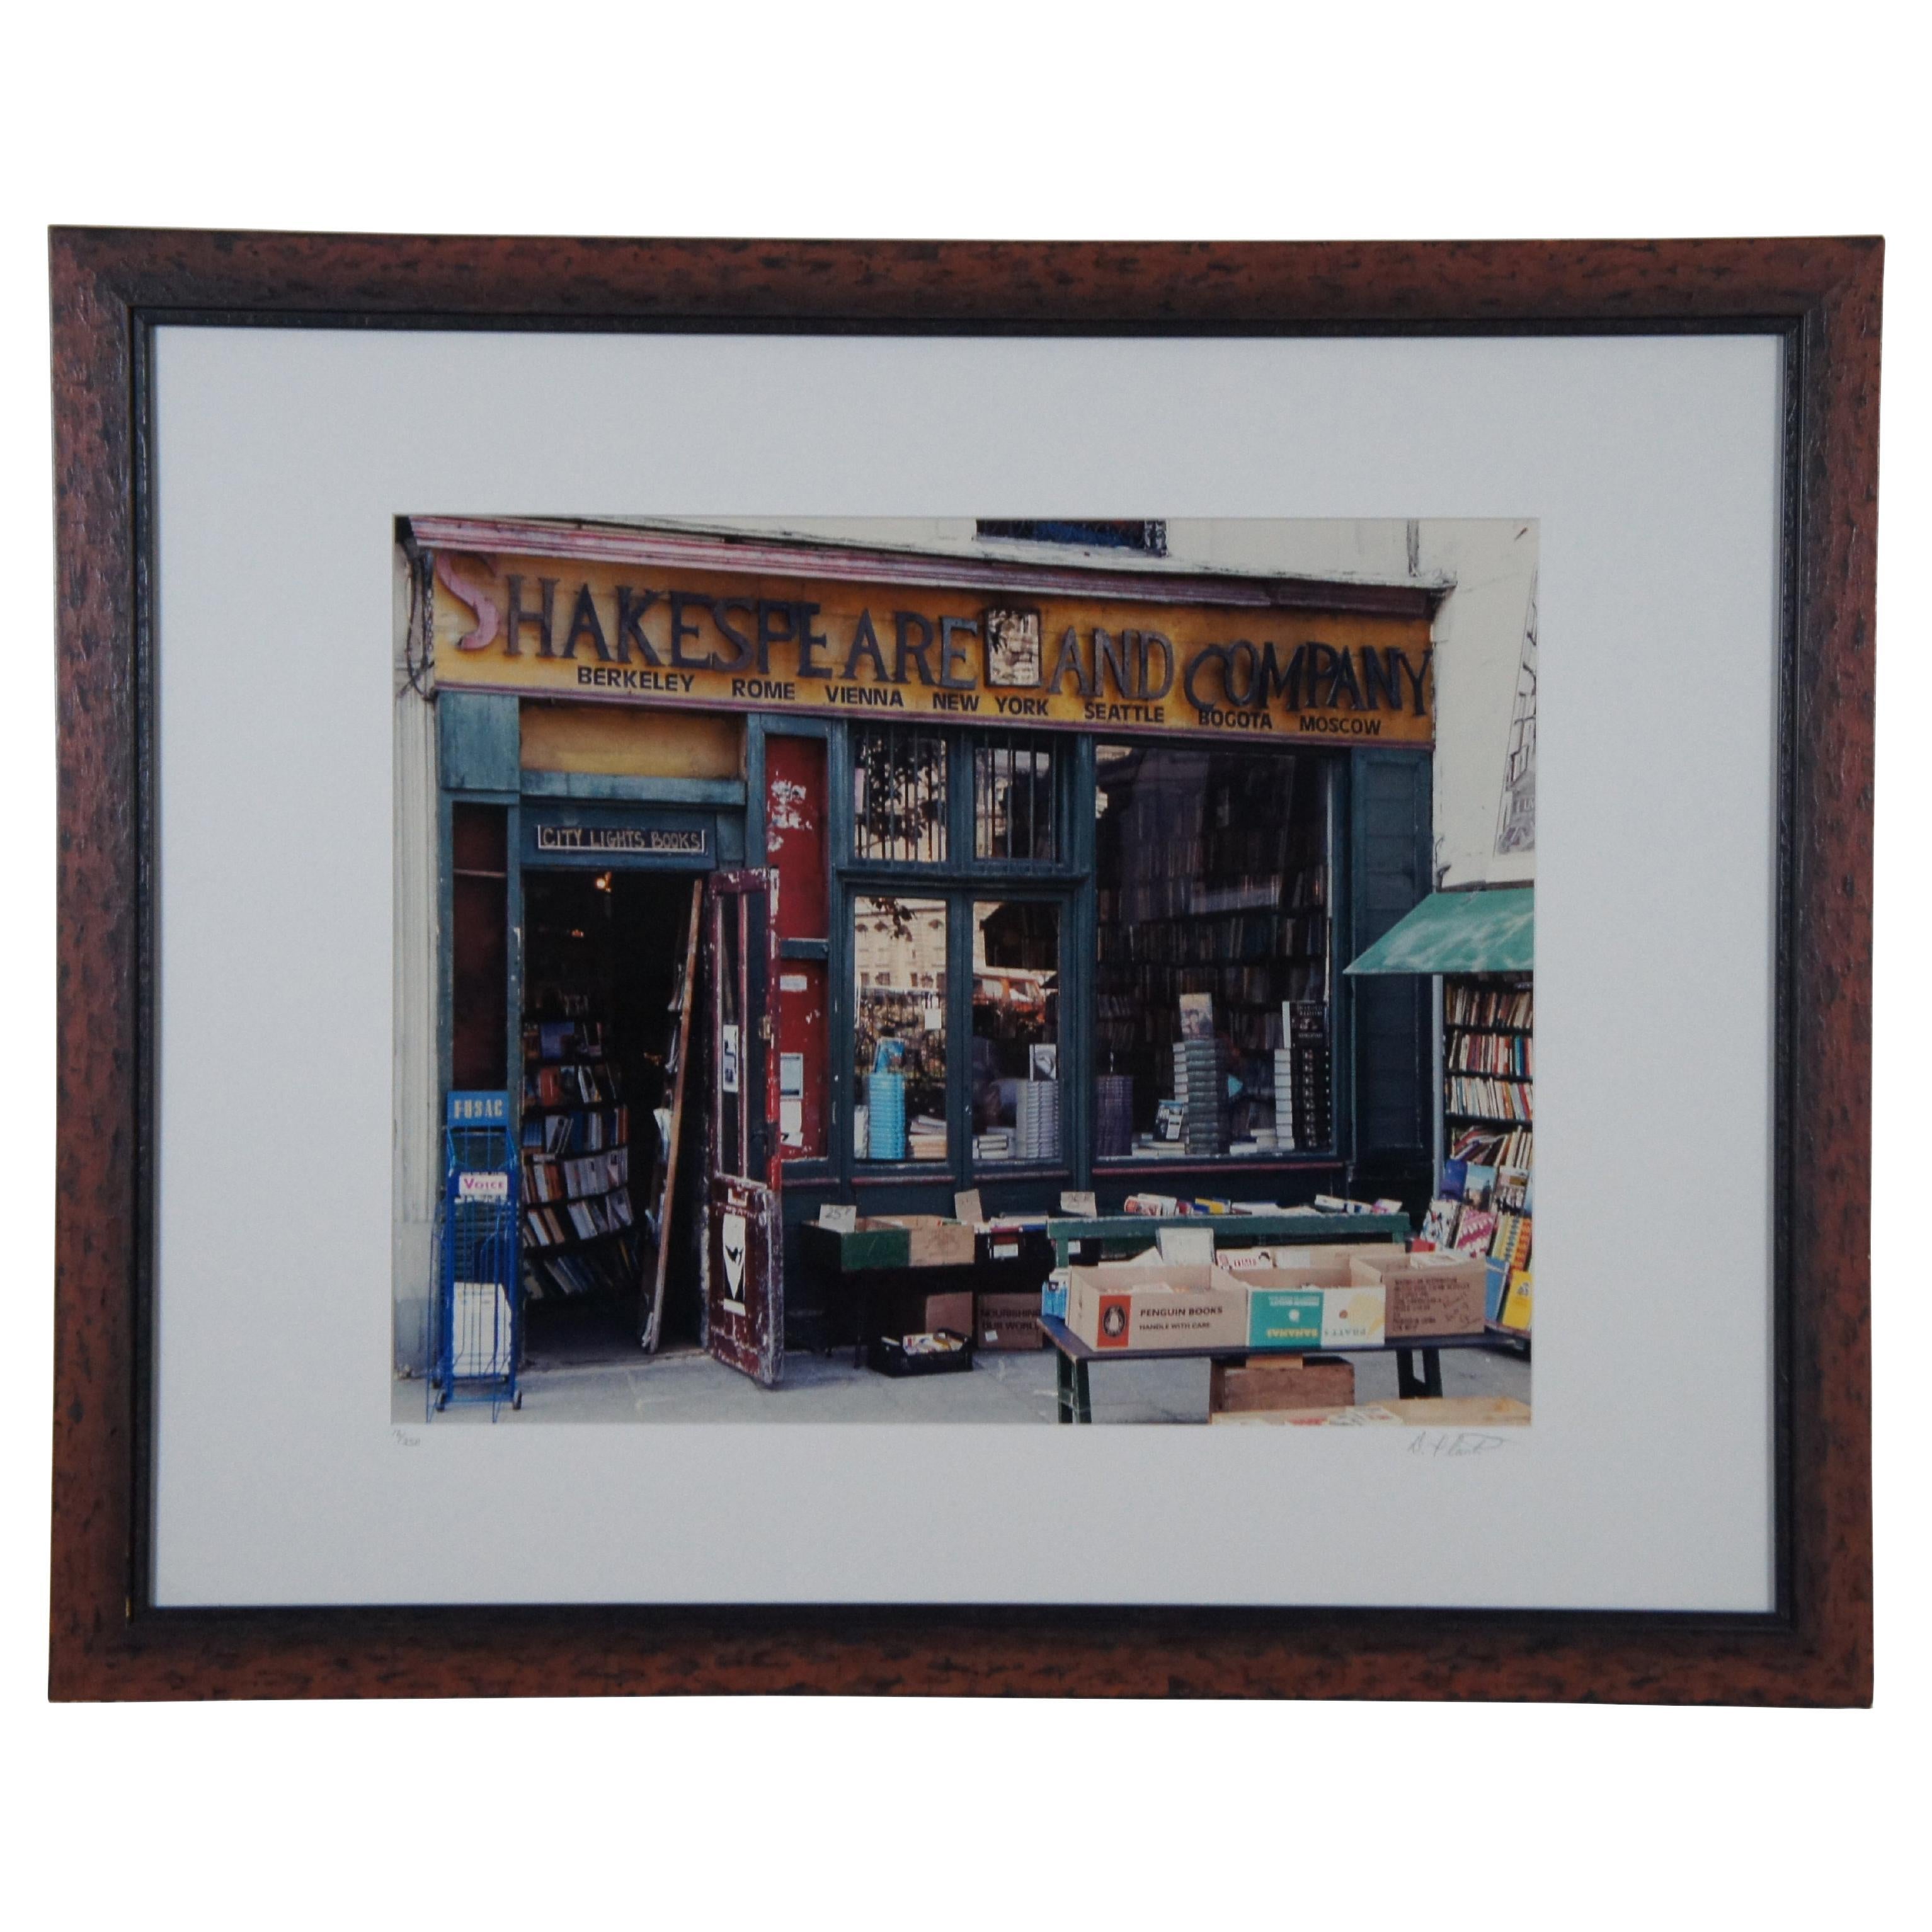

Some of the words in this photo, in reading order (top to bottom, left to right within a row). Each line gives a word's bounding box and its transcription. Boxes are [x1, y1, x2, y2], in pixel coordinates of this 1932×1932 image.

[436, 550, 978, 690] SHAKESPEARE
[1047, 626, 1175, 700] AND
[1184, 639, 1433, 717] COMPANY
[577, 666, 696, 693] BERKELEY
[731, 678, 796, 700] ROME
[825, 685, 905, 708] VIENNA
[932, 692, 980, 712] NEW
[995, 696, 1049, 717] YORK
[1084, 701, 1165, 724] SEATTLE
[1198, 709, 1273, 730] BOGOTA
[1299, 714, 1382, 736] MOSCOW
[543, 827, 583, 847] CITY
[590, 830, 646, 849] LIGHTS
[651, 830, 701, 850] BOOKS
[454, 1099, 503, 1119] FUSAC
[1140, 1308, 1186, 1317] PENGUIN
[1189, 1305, 1223, 1316] BOOKS
[1191, 1321, 1210, 1329] CARE
